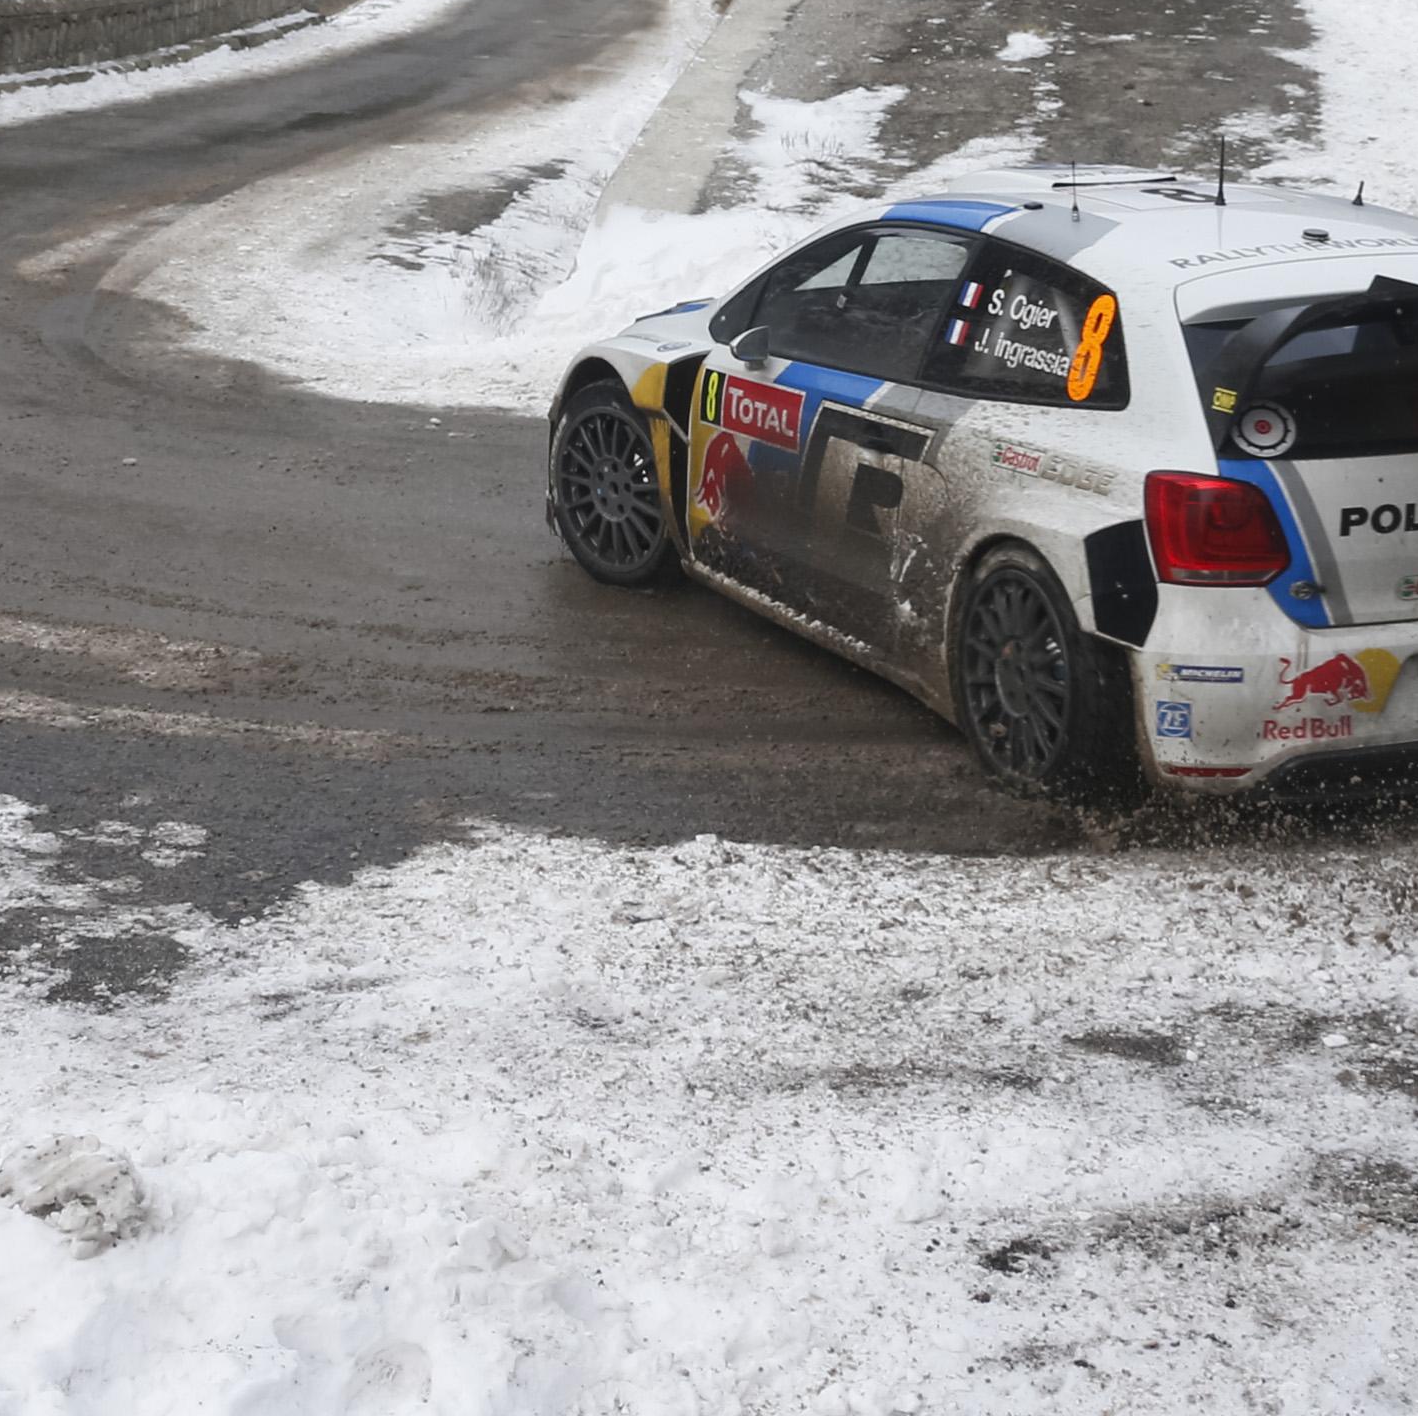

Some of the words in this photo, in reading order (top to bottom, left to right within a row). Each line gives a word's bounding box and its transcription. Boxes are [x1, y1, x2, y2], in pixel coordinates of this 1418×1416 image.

[987, 288, 1004, 316] S.
[1010, 294, 1058, 330] Ogier
[974, 328, 990, 354] J.
[1067, 294, 1116, 401] 8
[706, 371, 719, 422] 8
[728, 387, 795, 437] TOTAL
[1262, 717, 1307, 740] Red
[1309, 715, 1352, 738] Bull
